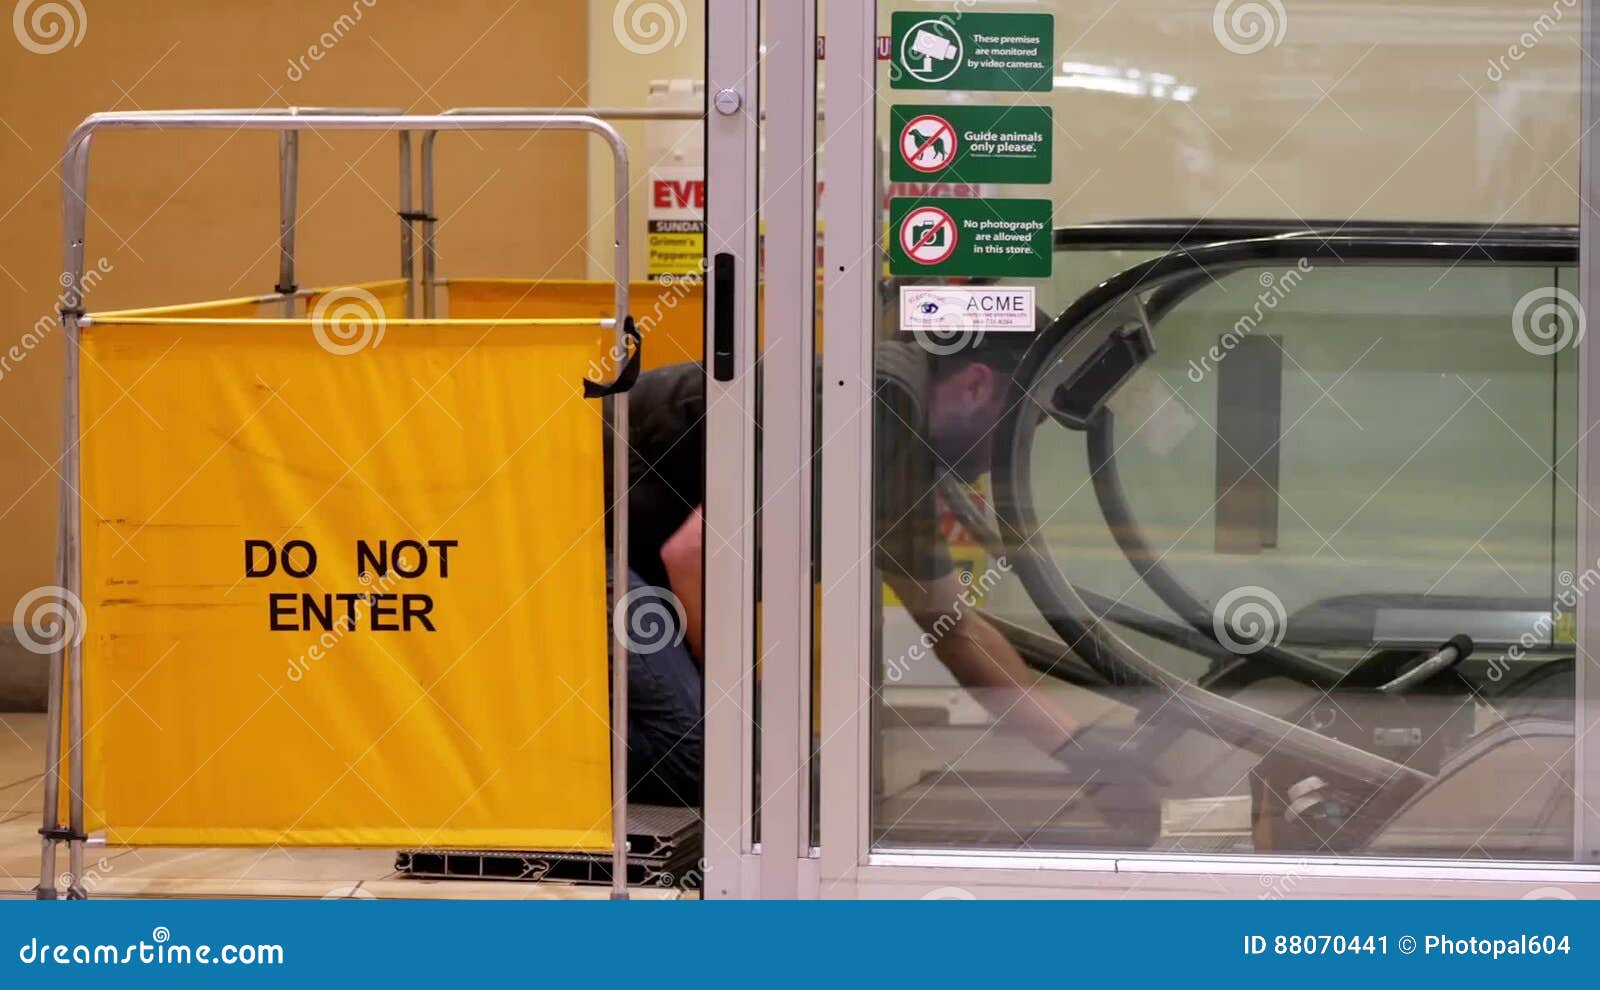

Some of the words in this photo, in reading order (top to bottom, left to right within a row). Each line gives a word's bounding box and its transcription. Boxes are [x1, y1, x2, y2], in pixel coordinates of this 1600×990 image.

[973, 34, 999, 43] These
[1001, 35, 1040, 45] premises
[991, 48, 1037, 56] monitored
[967, 59, 979, 69] by
[980, 60, 1004, 68] video
[1006, 61, 1044, 69] cameras.
[964, 131, 998, 141] Guide
[1000, 132, 1042, 142] animals
[970, 142, 995, 153] only
[963, 220, 978, 228] No
[980, 220, 1044, 231] photographs
[975, 233, 991, 241] are
[993, 232, 1032, 241] allowed
[974, 244, 984, 253] in
[985, 245, 1004, 253] this
[1005, 245, 1033, 254] store.
[966, 296, 1025, 311] ACME
[244, 540, 318, 578] DO
[356, 540, 458, 578] NOT
[269, 593, 436, 632] ENTER
